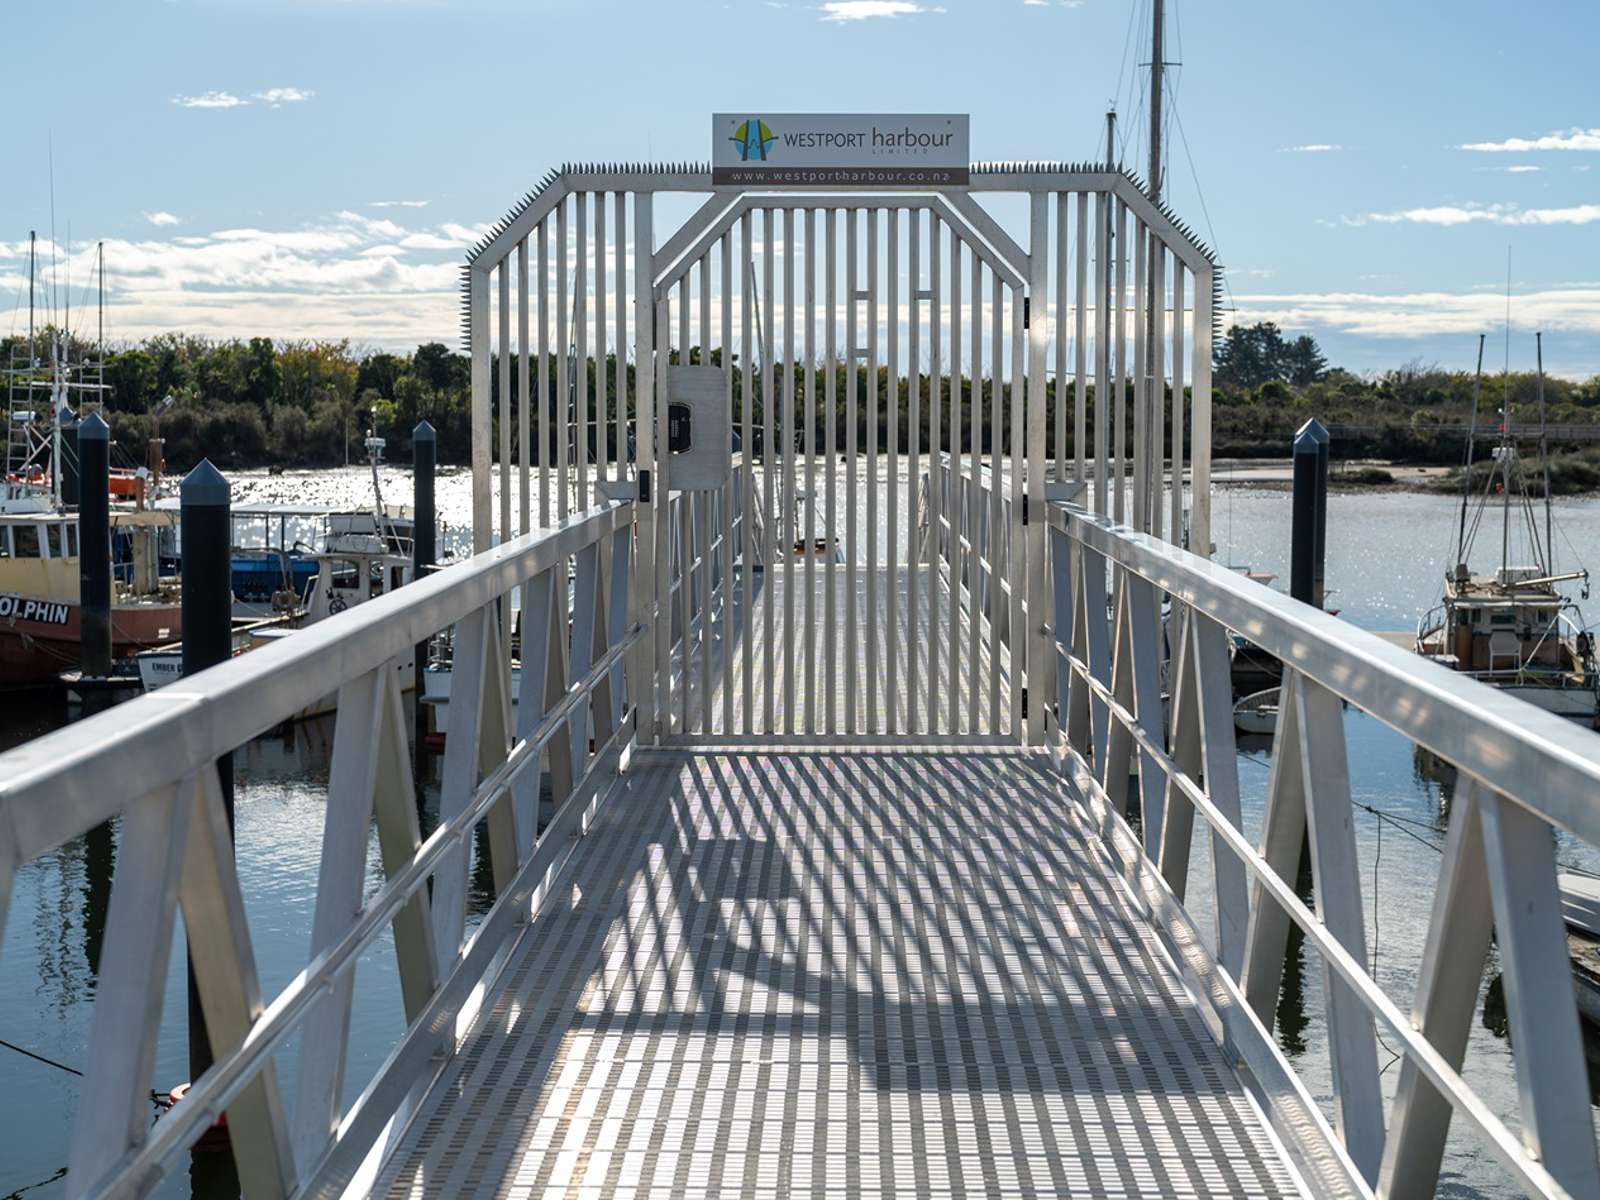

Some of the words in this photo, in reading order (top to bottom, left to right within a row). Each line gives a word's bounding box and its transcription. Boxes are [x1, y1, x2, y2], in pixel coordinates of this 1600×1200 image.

[783, 133, 866, 148] WESTPORT
[872, 127, 954, 147] harbour
[732, 171, 950, 182] www.westportharbour.co.nz
